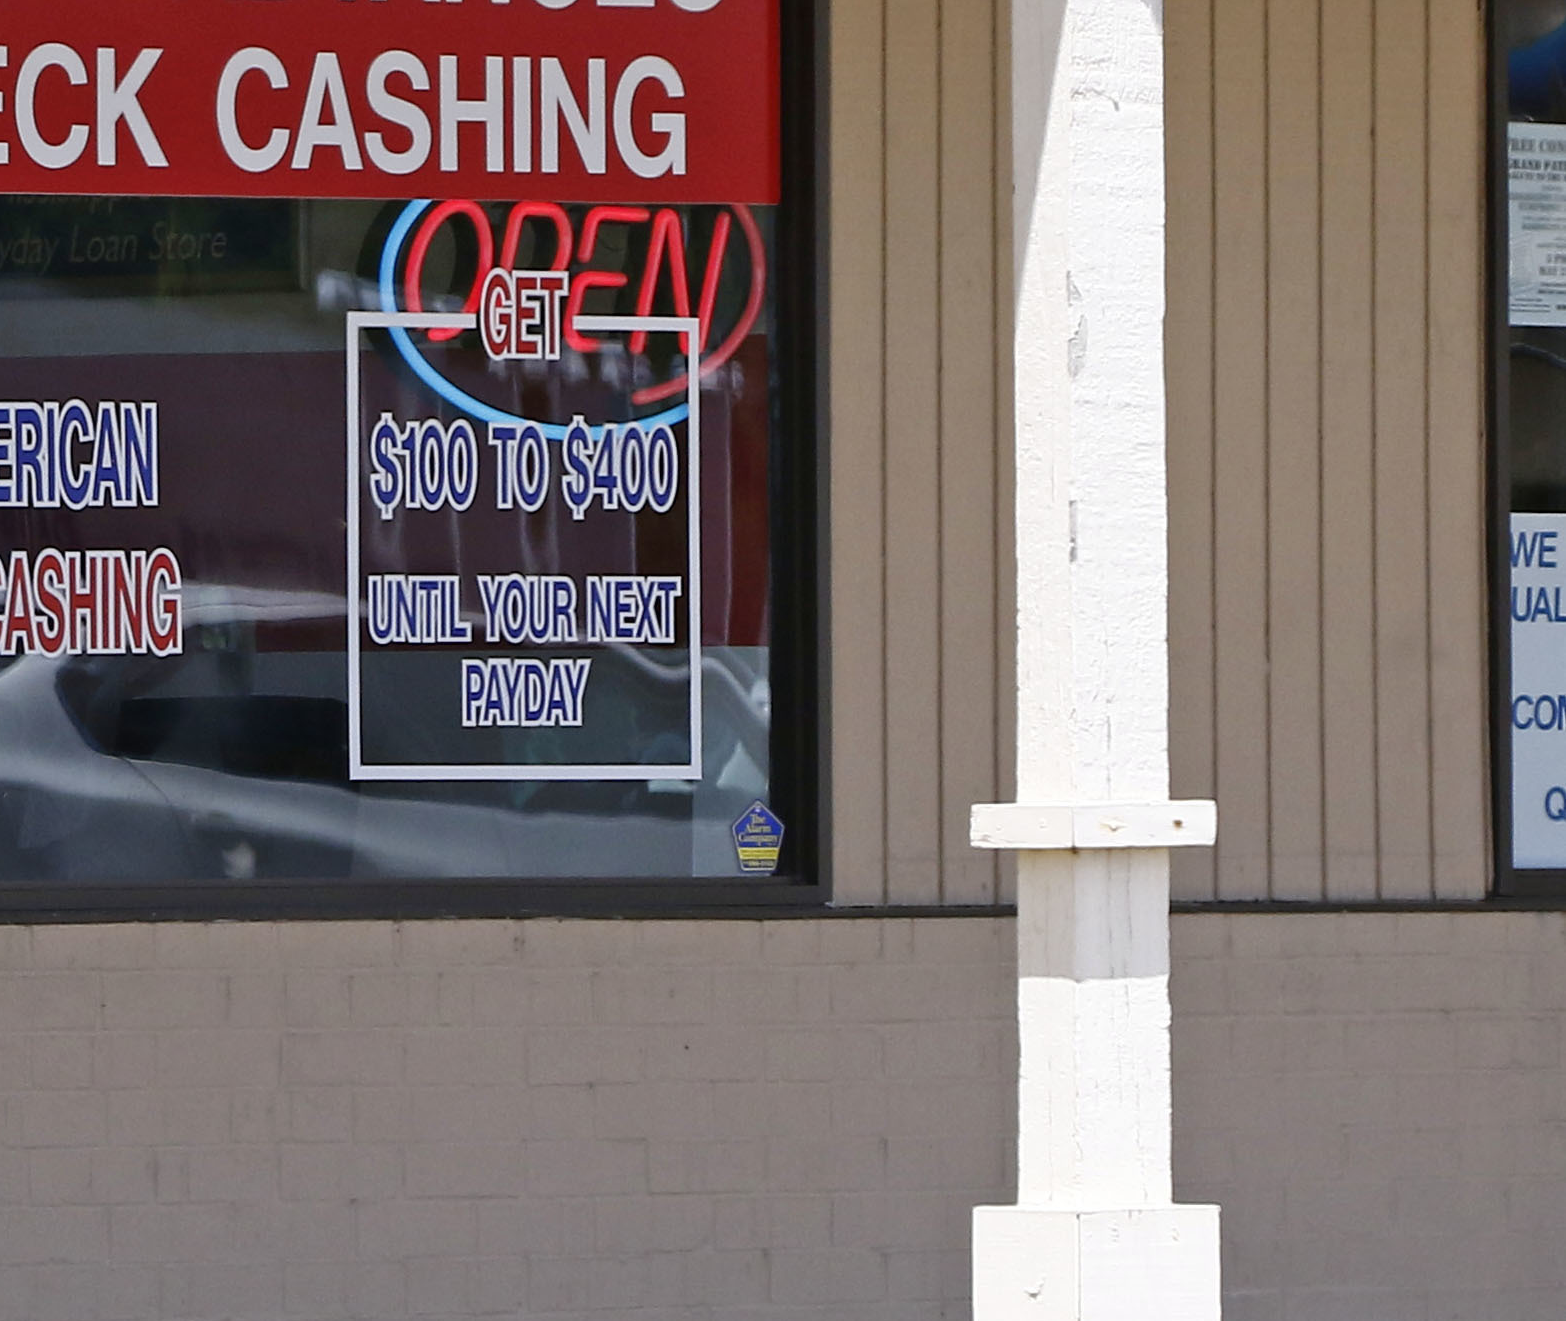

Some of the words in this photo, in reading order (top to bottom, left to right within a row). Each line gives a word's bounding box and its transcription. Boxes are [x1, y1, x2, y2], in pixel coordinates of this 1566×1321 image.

[216, 49, 687, 175] CASHING
[69, 225, 137, 263] Loan
[149, 221, 228, 262] Store
[405, 200, 730, 354] OPEN
[480, 267, 569, 361] GET
[370, 412, 478, 520] $100
[488, 421, 550, 512] TO
[562, 415, 678, 520] $400
[368, 575, 472, 644] UNTIL
[477, 573, 578, 643] YOUR
[586, 576, 682, 643] NEXT
[462, 658, 592, 726] PAYDAY
